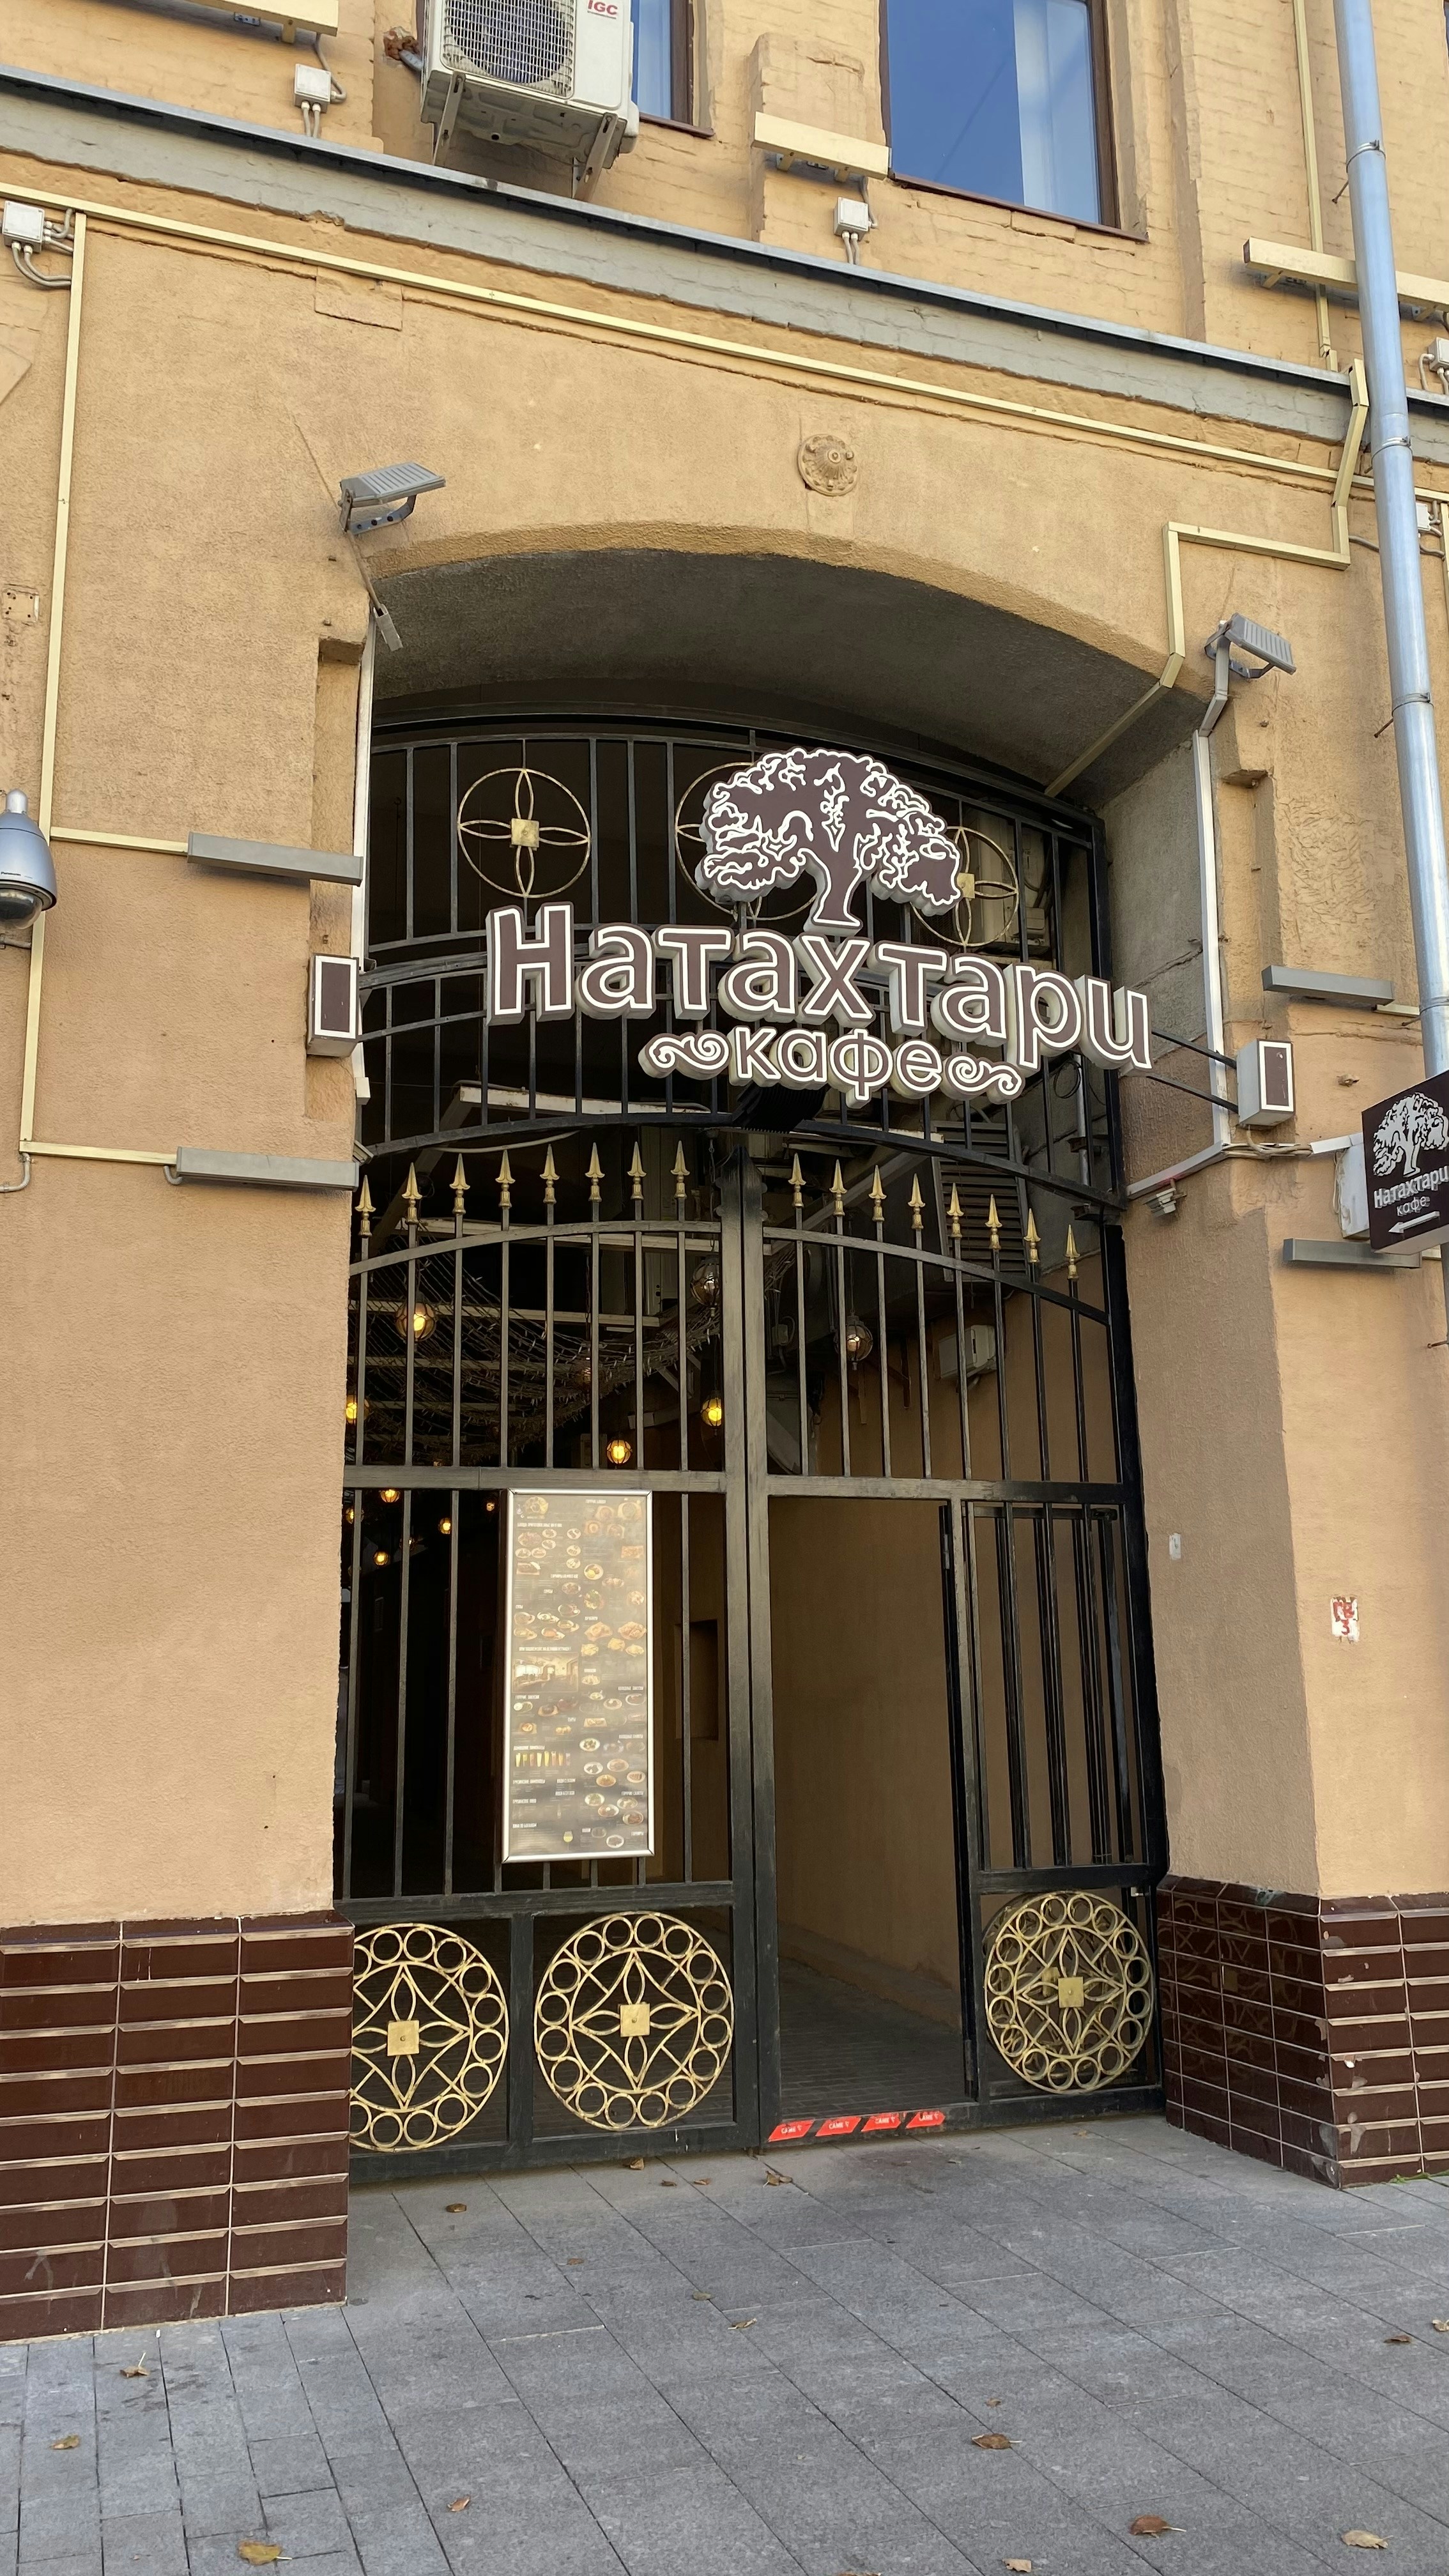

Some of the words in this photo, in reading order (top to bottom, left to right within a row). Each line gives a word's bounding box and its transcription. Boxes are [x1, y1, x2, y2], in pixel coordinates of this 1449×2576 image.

[588, 0, 618, 15] IGC
[488, 901, 1152, 1075] Натахтари
[732, 1025, 943, 1107] кафе
[1397, 1196, 1430, 1216] кафе
